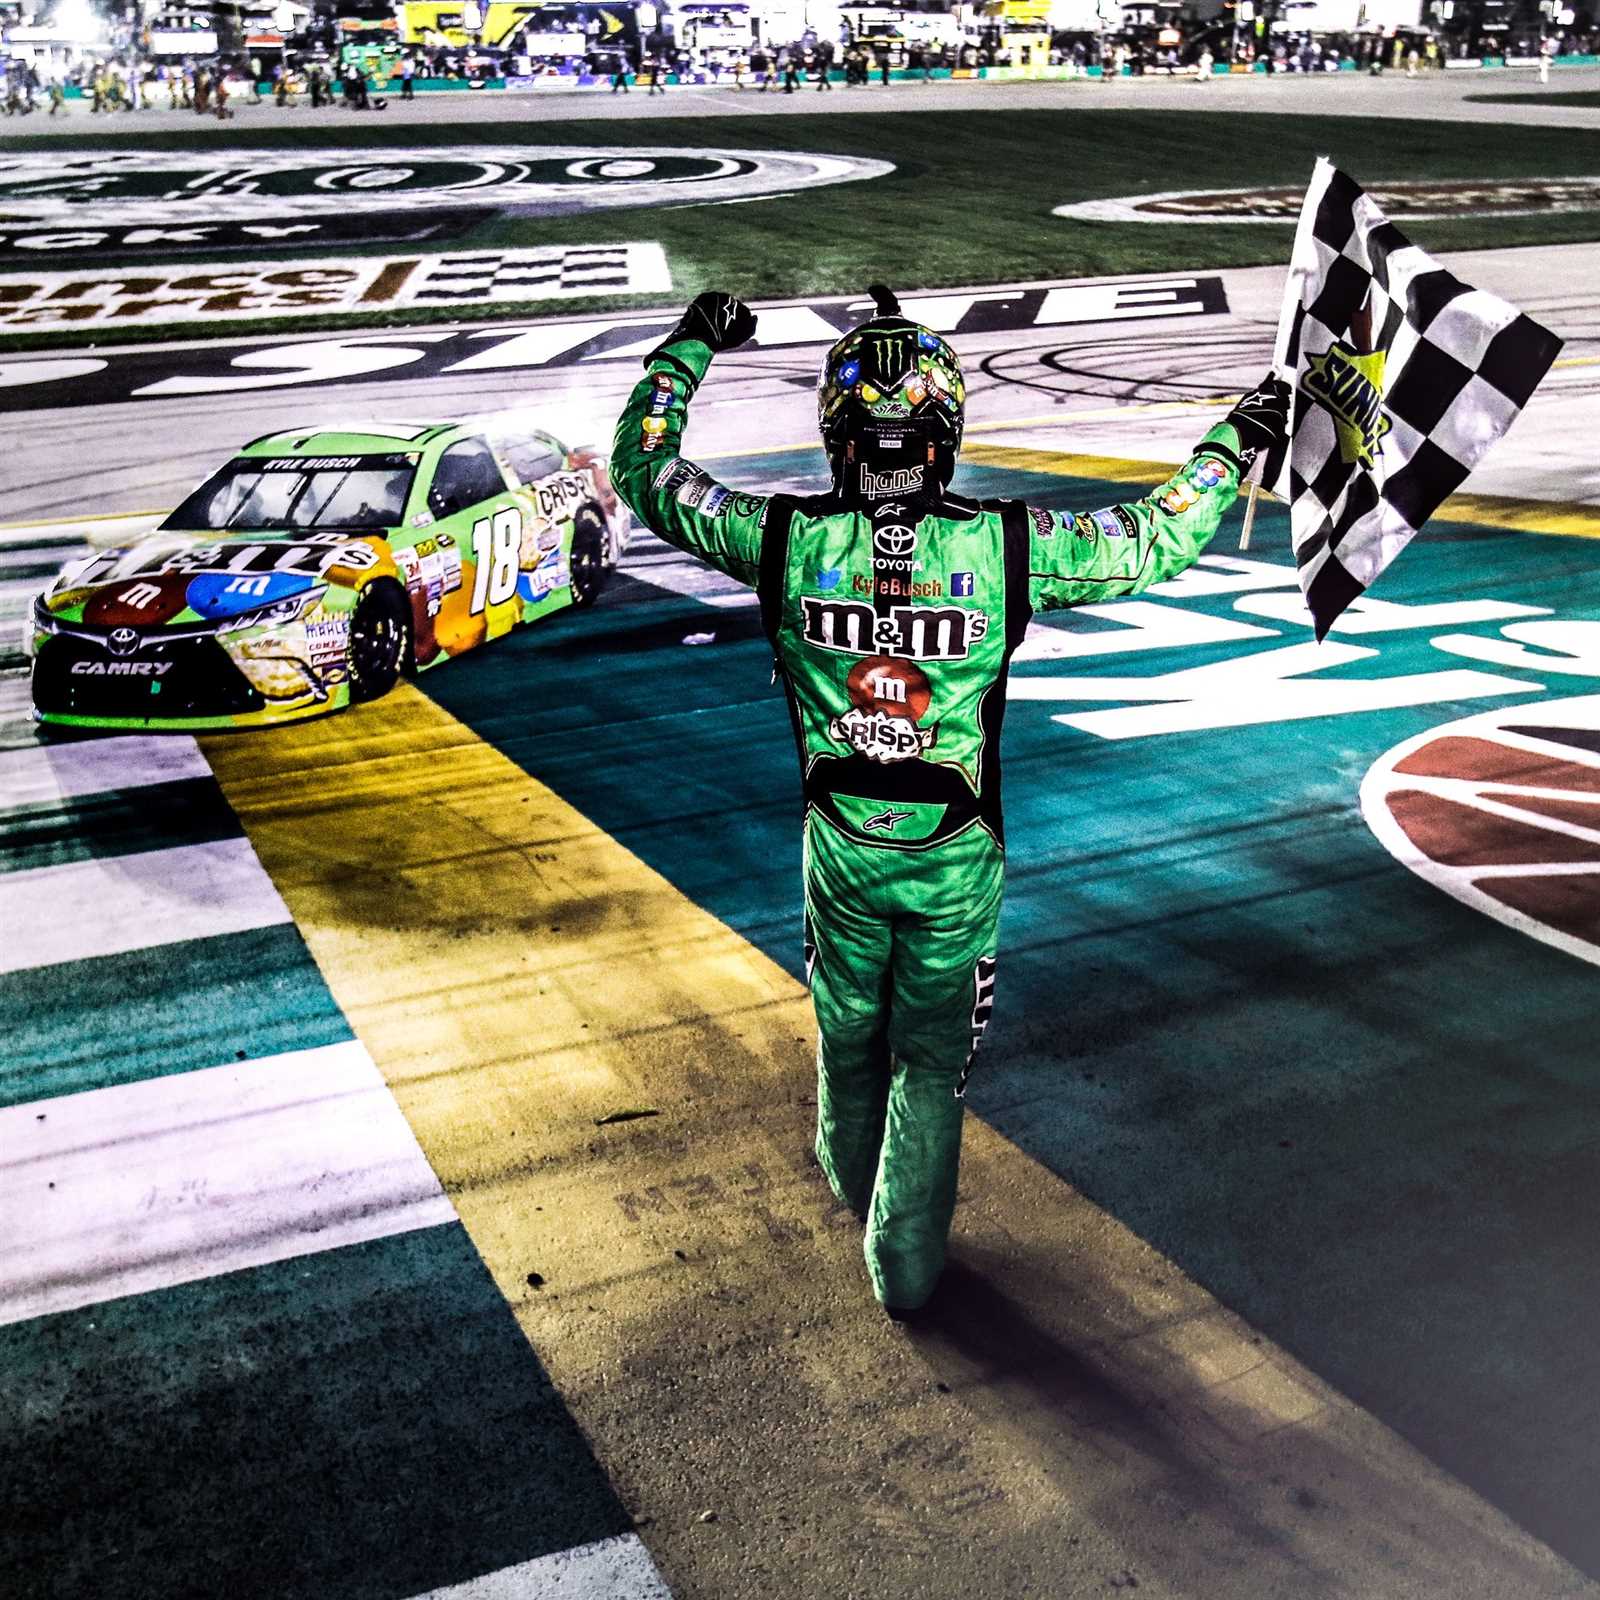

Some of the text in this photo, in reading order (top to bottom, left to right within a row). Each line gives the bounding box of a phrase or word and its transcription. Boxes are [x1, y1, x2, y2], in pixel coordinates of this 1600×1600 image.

[263, 457, 362, 470] KYLE BUSCH
[861, 463, 924, 500] hans
[469, 505, 523, 617] 18
[869, 557, 922, 571] TOYOTA
[852, 573, 942, 597] KyleBusch
[70, 661, 174, 676] CAMRY
[873, 676, 907, 703] m
